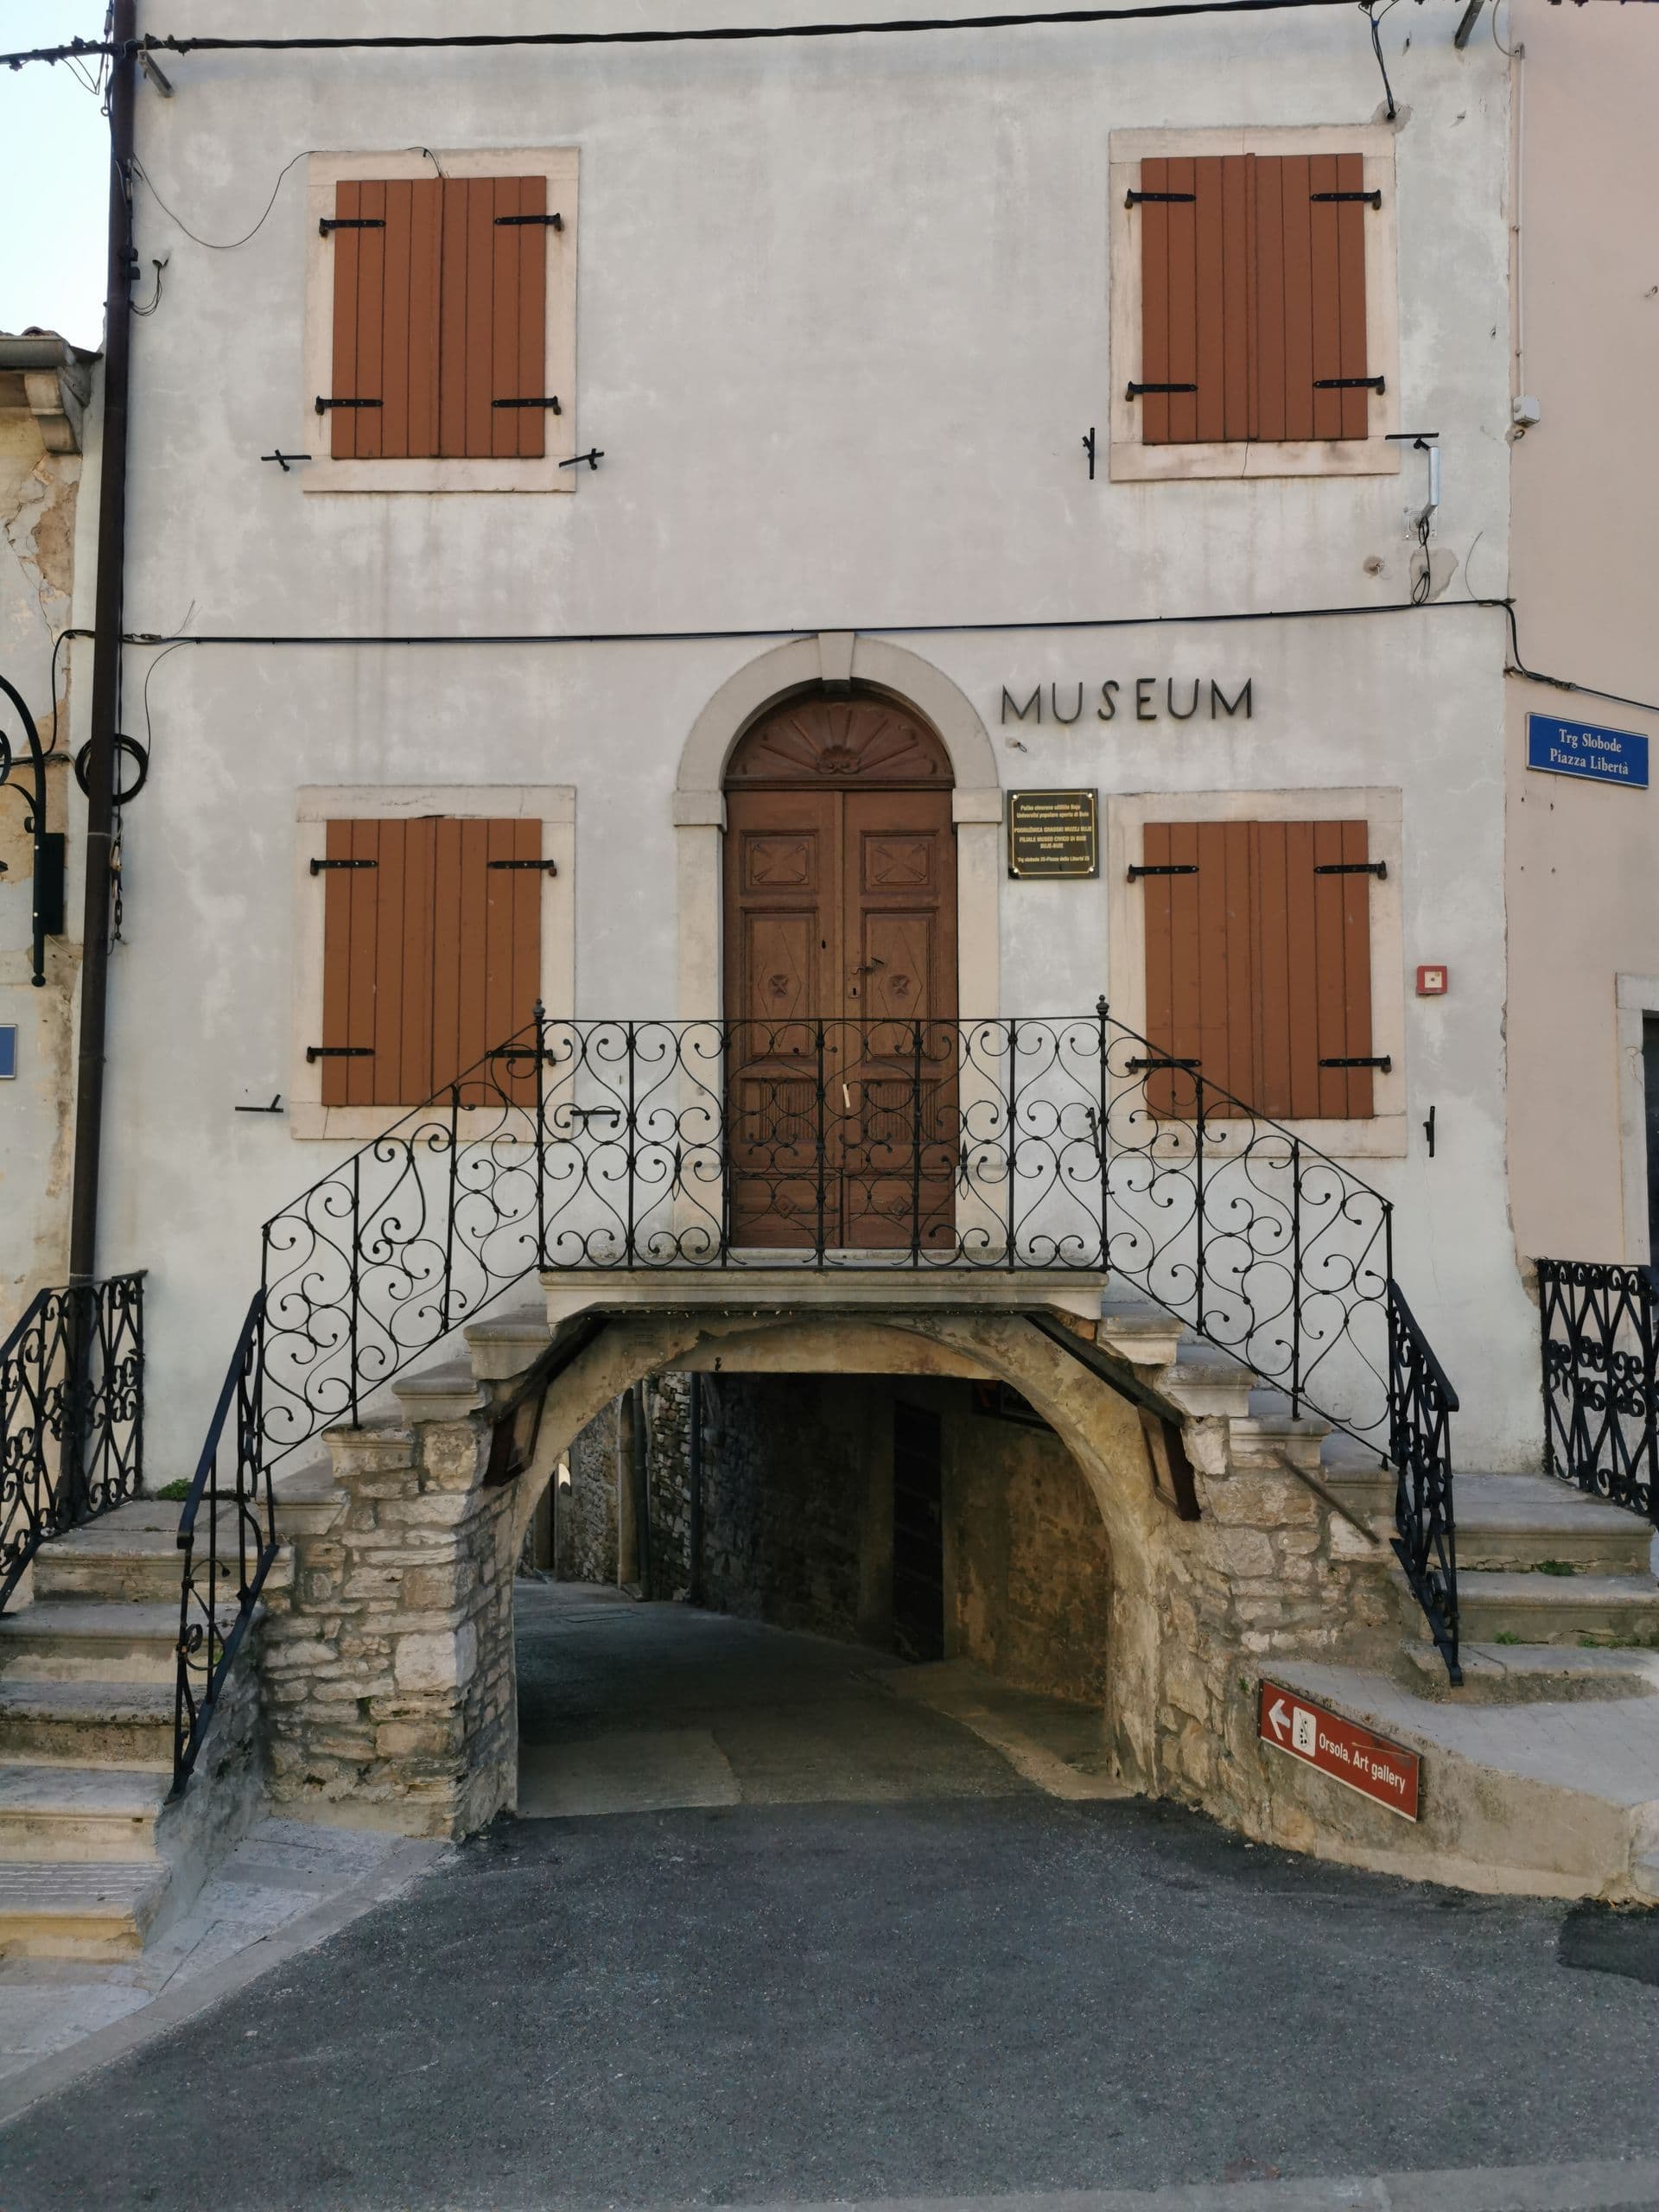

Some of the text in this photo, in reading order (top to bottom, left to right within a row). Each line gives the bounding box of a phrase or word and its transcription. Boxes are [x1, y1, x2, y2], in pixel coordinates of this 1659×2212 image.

[1001, 677, 1252, 724] MUSEUM
[1559, 728, 1622, 753] Trg Slobode
[1549, 747, 1629, 775] Piazza Libertà
[1319, 1732, 1406, 1794] Orsola, Art gallery
